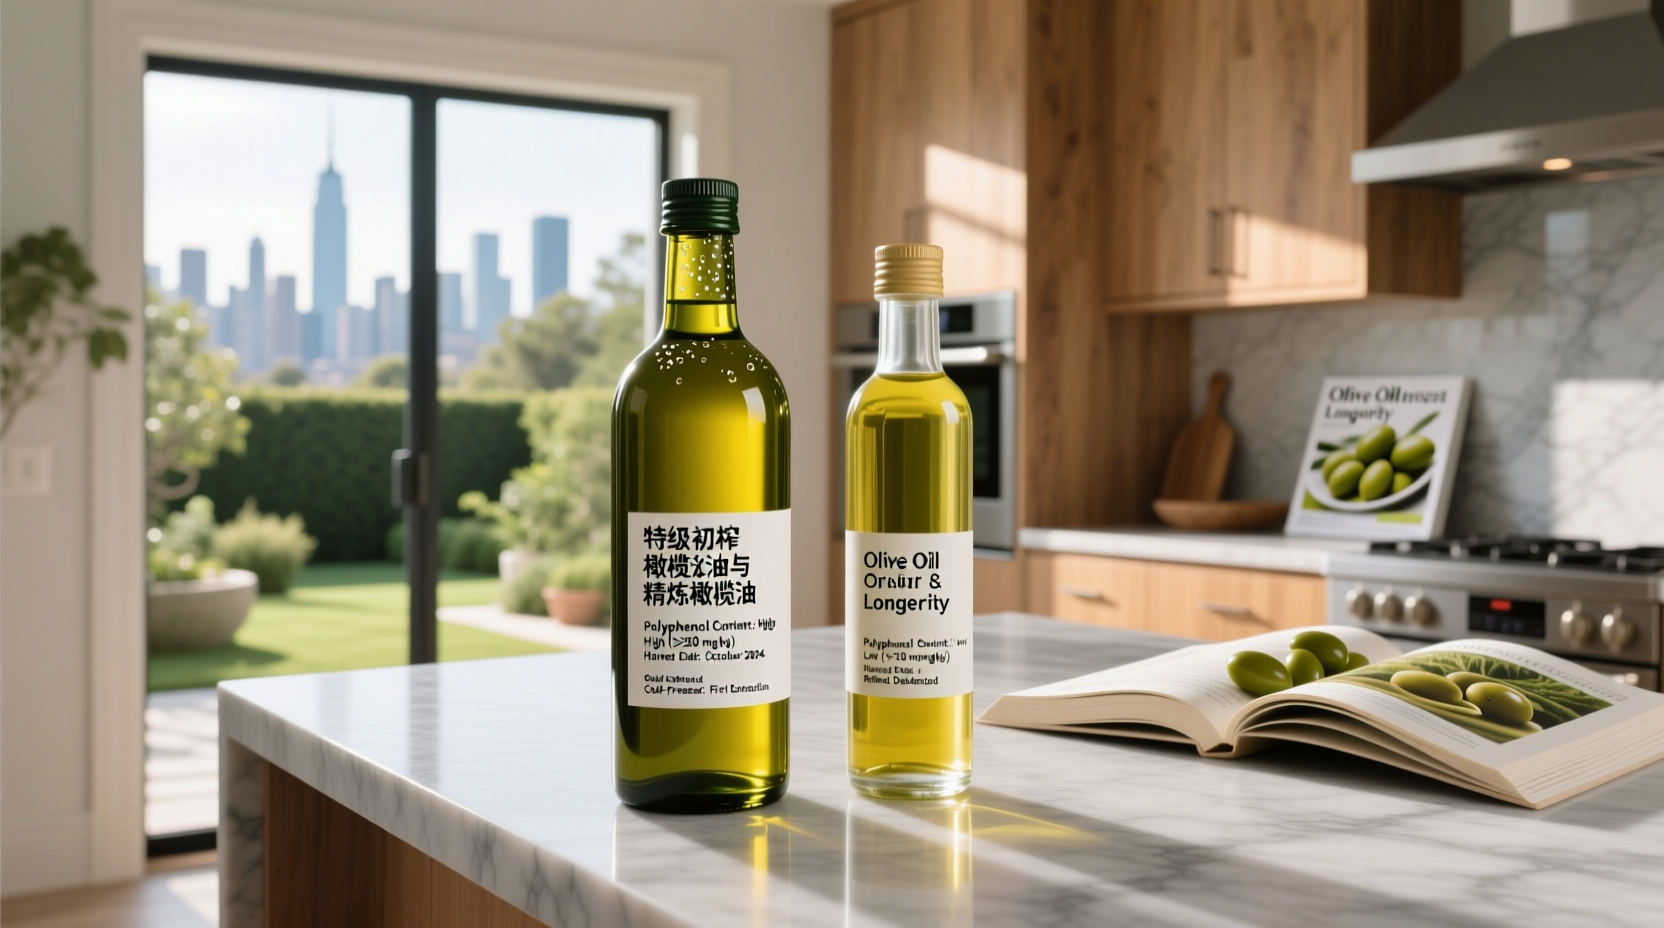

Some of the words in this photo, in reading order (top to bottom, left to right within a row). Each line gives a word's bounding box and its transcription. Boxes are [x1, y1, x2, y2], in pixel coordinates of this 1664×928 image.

[1329, 386, 1371, 403] Olive
[643, 524, 741, 551] 特级初榨
[864, 551, 908, 569] Olive
[929, 573, 942, 589] &
[864, 593, 950, 615] Longerity
[644, 619, 710, 637] Polyphenol
